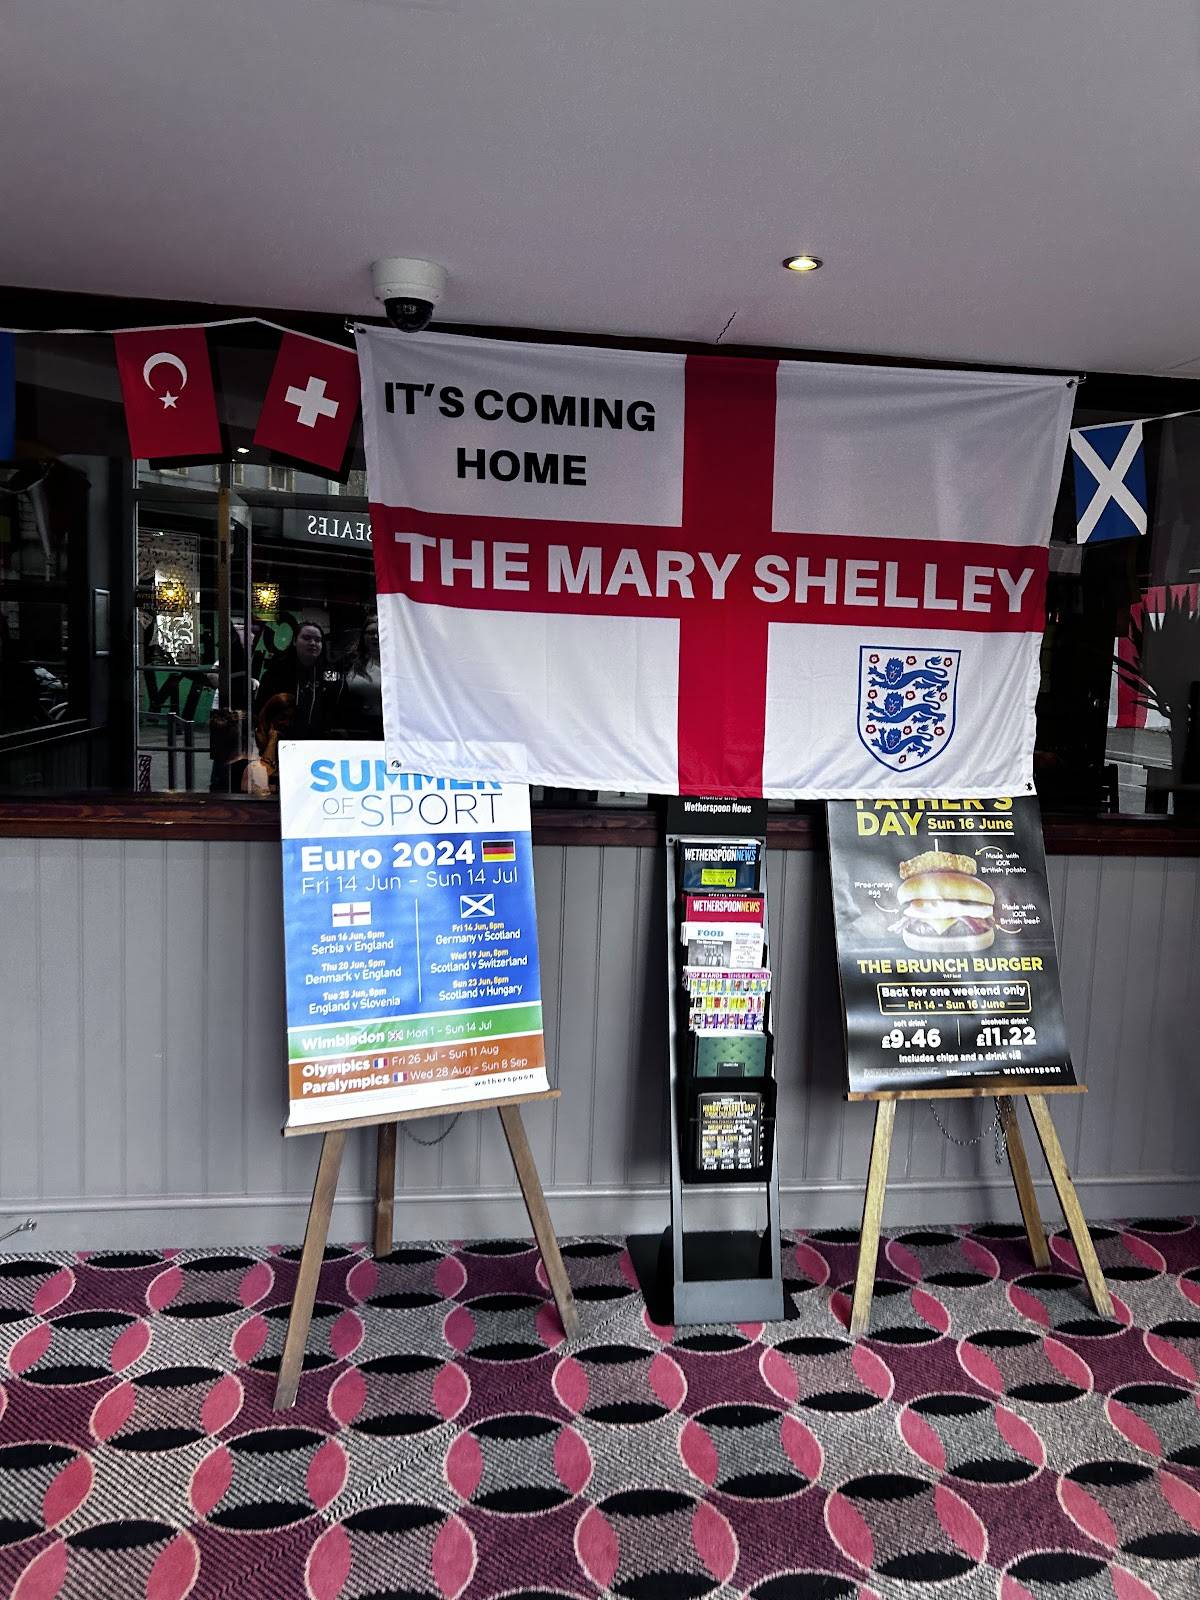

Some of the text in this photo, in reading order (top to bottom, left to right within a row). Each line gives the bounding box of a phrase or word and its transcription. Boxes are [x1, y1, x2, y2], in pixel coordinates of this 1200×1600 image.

[385, 382, 656, 432] IT'S COMING
[457, 448, 587, 486] HOME
[395, 533, 1034, 612] THE MARY SHELLEY
[323, 794, 502, 827] OF SPORT
[685, 802, 751, 813] Wetherspoon News
[857, 812, 922, 835] DAY
[928, 818, 1013, 830] Sun 16 June
[302, 840, 475, 872] Euro 2024
[302, 877, 328, 894] Fri
[337, 878, 357, 892] 14
[367, 876, 400, 891] Jun
[427, 871, 461, 888] Sun
[468, 869, 486, 884] 14
[493, 867, 518, 884] Jul
[349, 932, 366, 941] Jun,
[436, 934, 476, 944] Germany
[485, 929, 520, 941] Scotland
[312, 944, 343, 955] Serbia
[355, 939, 393, 952] England
[431, 962, 469, 973] Scotland
[479, 955, 528, 969] Switzerland
[450, 952, 466, 960] Wed
[321, 963, 337, 971] Thu
[350, 961, 366, 969] Jun,
[857, 957, 1043, 973] THE BRUNCH BURGER
[305, 972, 352, 985] Denmark
[363, 966, 402, 980] England
[453, 980, 467, 988] Sun
[882, 985, 1025, 997] Back for one weekend only
[323, 992, 338, 1000] Tue
[351, 990, 367, 998] Jun,
[439, 989, 477, 1001] Scotland
[486, 985, 522, 996] Hungary
[309, 1002, 350, 1015] England
[360, 996, 400, 1009] Slovenia
[908, 1001, 922, 1010] Fri
[924, 1001, 935, 1009] 14
[946, 1001, 964, 1009] Sun
[967, 1000, 978, 1009] 16
[981, 1000, 1004, 1008] June
[302, 1032, 384, 1050] Wimbledon
[407, 1029, 427, 1038] Mon
[446, 1024, 463, 1034] Sun
[479, 1020, 491, 1030] Jul
[882, 1028, 941, 1048] £9.46
[977, 1027, 1036, 1046] £11.22
[302, 1060, 370, 1077] Olympics
[392, 1056, 405, 1065] Fri
[409, 1055, 420, 1064] 26
[424, 1052, 438, 1062] Jul
[449, 1050, 467, 1060] Sun
[471, 1048, 477, 1056] 11
[480, 1046, 499, 1056] Aug
[899, 1054, 934, 1062] Includes
[937, 1054, 958, 1063] chips
[960, 1053, 976, 1061] and
[303, 1074, 389, 1094] Paralympics
[410, 1070, 432, 1080] Wed
[437, 1068, 448, 1077] 28
[452, 1066, 471, 1075] Aug
[482, 1062, 499, 1071] Sun
[502, 1060, 507, 1069] 8
[510, 1058, 528, 1069] Sep
[1004, 1066, 1061, 1075] wetherspoon
[475, 1074, 533, 1086] wetherspoon
